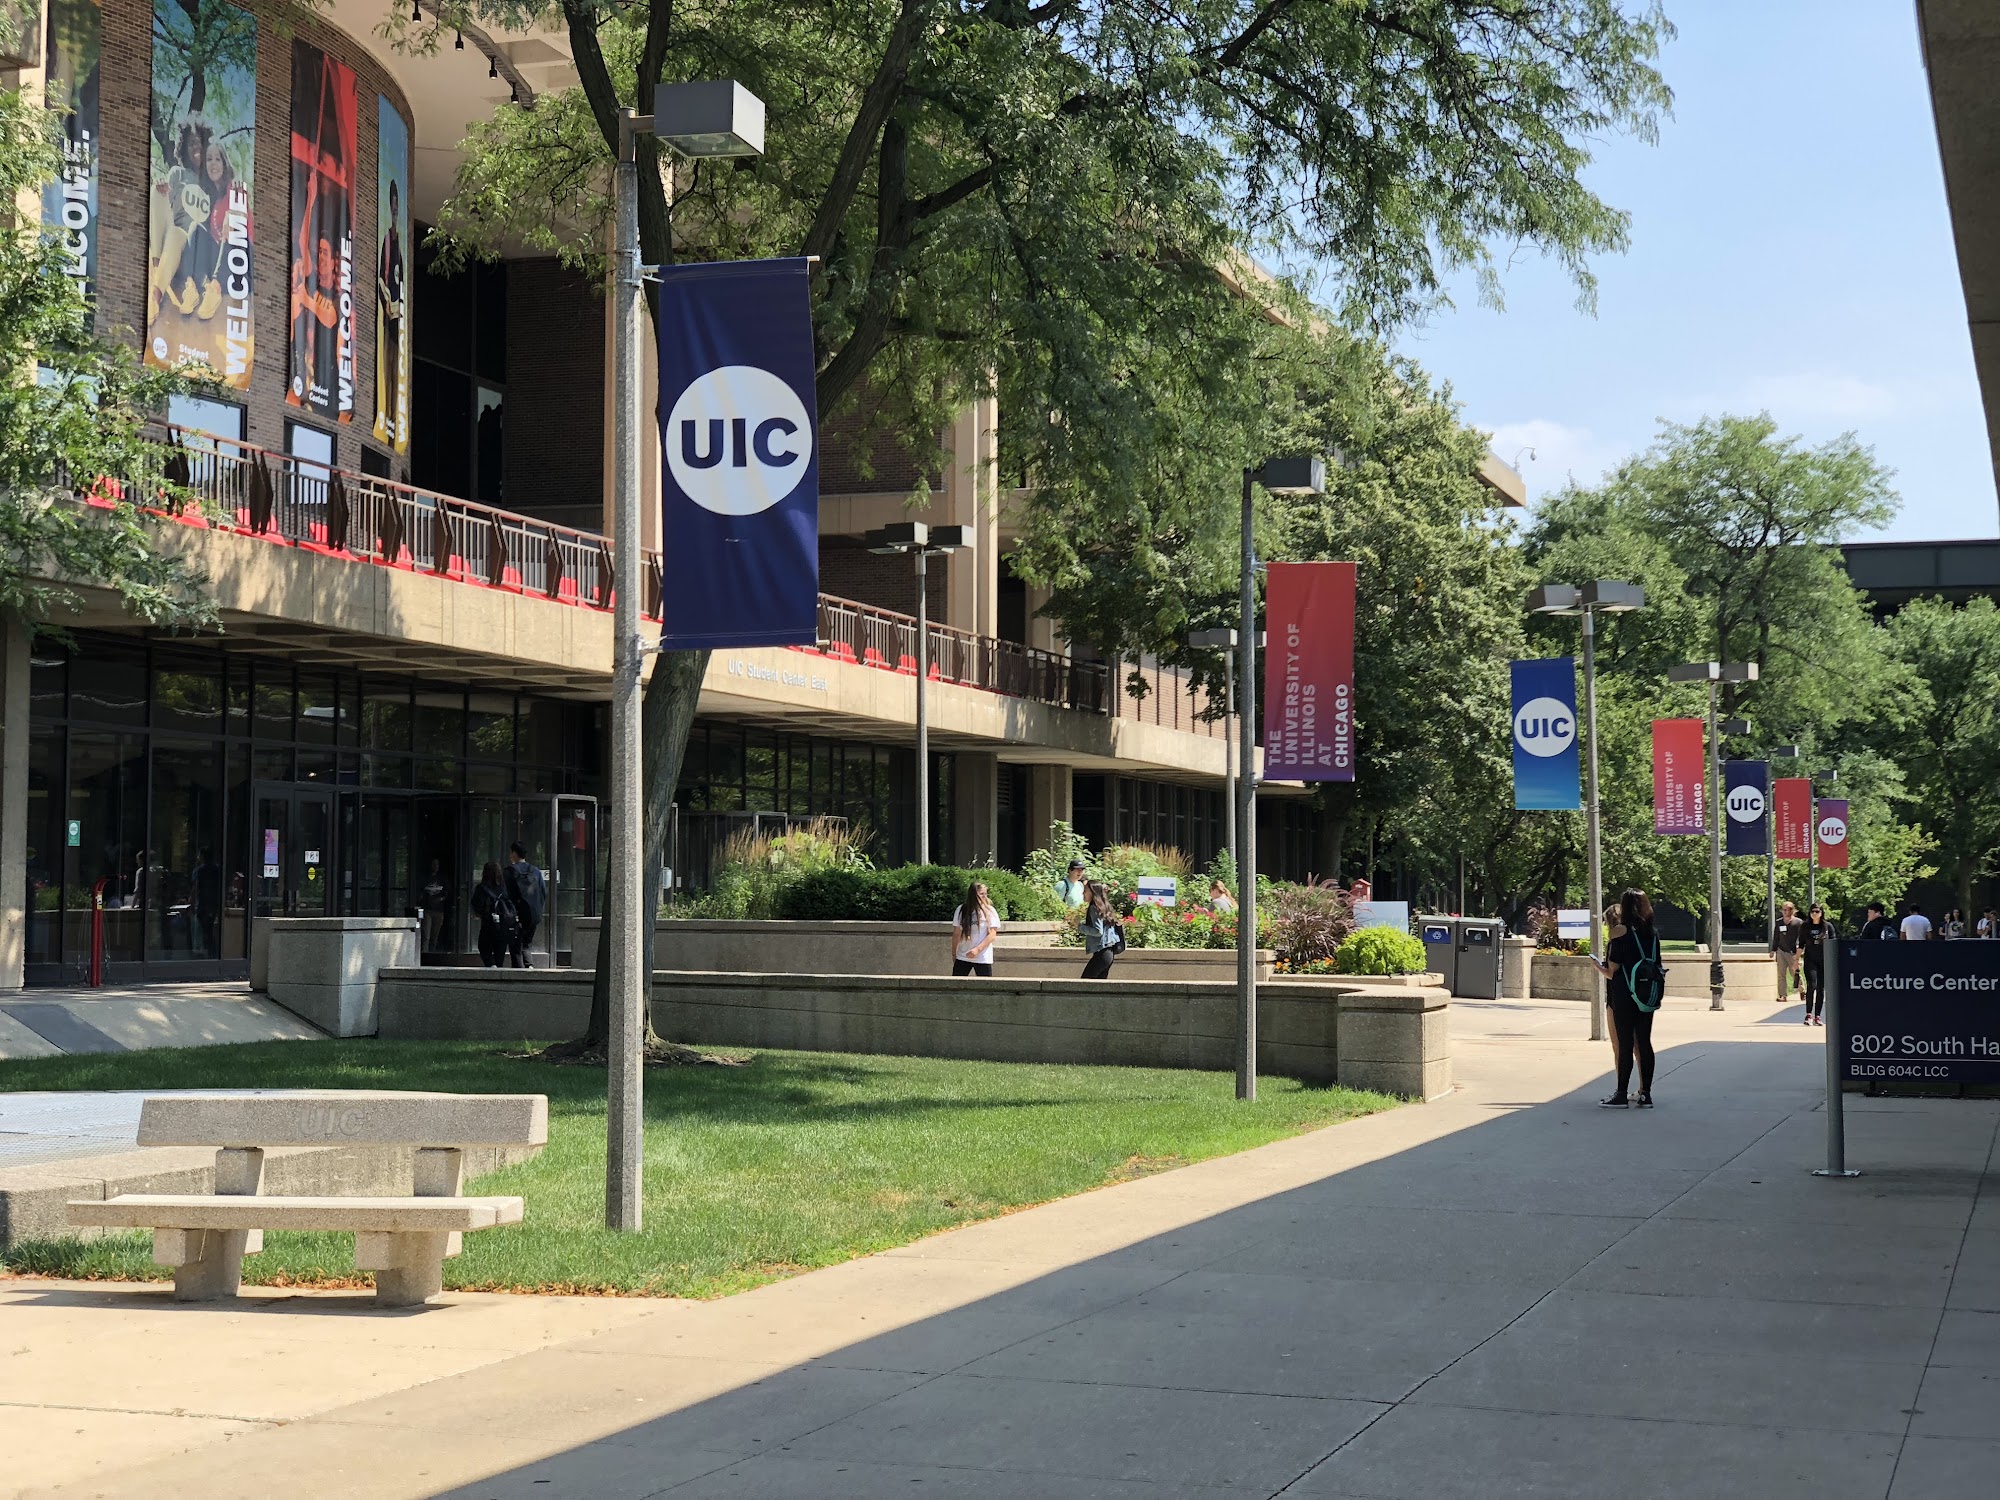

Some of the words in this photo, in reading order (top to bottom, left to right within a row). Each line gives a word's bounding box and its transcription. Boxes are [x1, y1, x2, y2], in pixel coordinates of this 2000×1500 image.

[61, 129, 90, 301] LCOME.
[185, 190, 210, 214] UIC
[339, 230, 352, 411] WELCOME.
[681, 417, 800, 470] UIC
[1287, 623, 1300, 648] OF
[728, 658, 743, 676] UIC
[747, 663, 778, 683] Student
[782, 670, 806, 688] Center
[811, 674, 828, 691] East
[1285, 652, 1300, 765] UNIVERSITY
[1302, 684, 1316, 765] ILLINOIS
[1335, 684, 1349, 768] CHICAGO
[1521, 717, 1570, 739] UIC
[1268, 730, 1282, 766] THE
[1319, 743, 1332, 766] AT
[1665, 751, 1673, 764] OF
[1666, 767, 1674, 827] UNIVERSITY
[1675, 783, 1684, 827] ILLINOIS
[1694, 783, 1703, 828] CHICAGO
[1730, 798, 1761, 811] UIC
[1657, 808, 1665, 827] THE
[1686, 815, 1693, 827] AT
[1821, 826, 1844, 837] UIC
[1849, 972, 1925, 990] Lecture
[1929, 973, 1999, 991] Center
[1851, 1035, 1895, 1054] 802
[1901, 1035, 1965, 1055] South
[1971, 1036, 2000, 1056] Ha
[1851, 1064, 1886, 1076] BLDG
[1888, 1065, 1922, 1077] 604C
[1924, 1066, 1949, 1077] LCC
[300, 1104, 365, 1136] UIC
